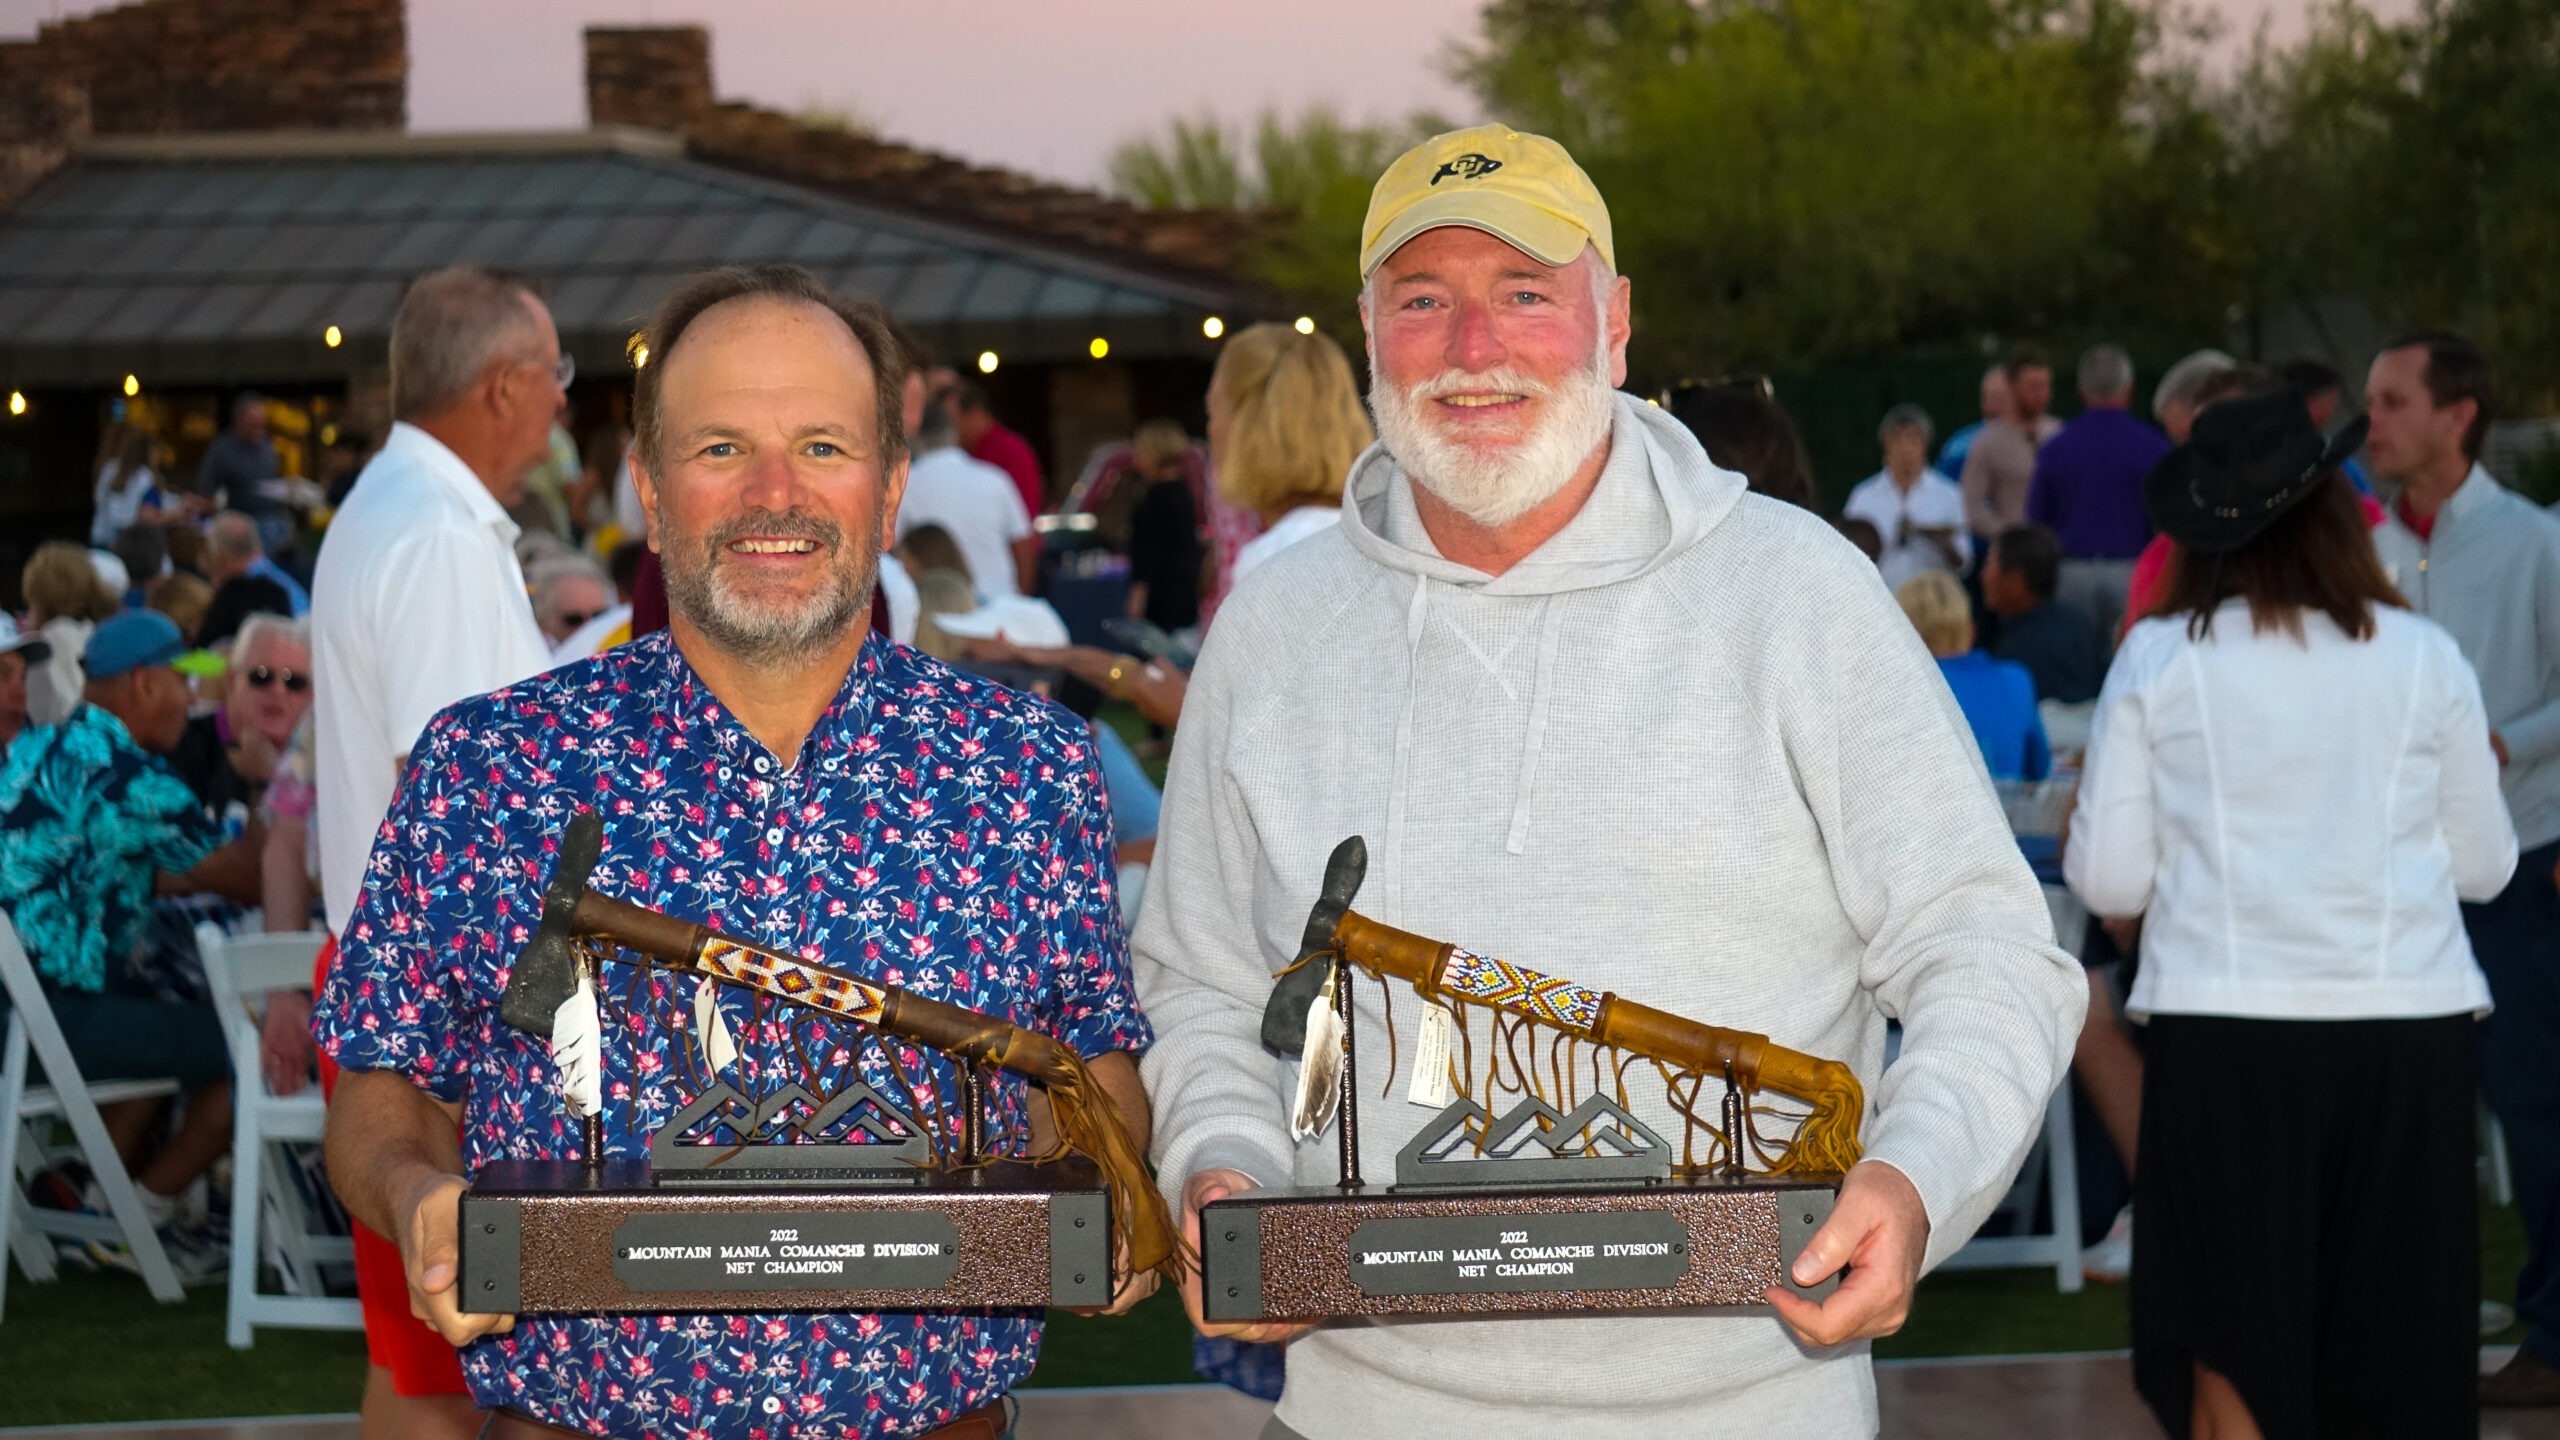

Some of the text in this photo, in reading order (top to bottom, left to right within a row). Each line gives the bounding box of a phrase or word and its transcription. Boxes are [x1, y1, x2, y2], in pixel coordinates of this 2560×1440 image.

[770, 1228, 799, 1242] 2022
[1500, 1230, 1529, 1244] 2022
[628, 1243, 940, 1260] MOUNTAIN MANIA COMANCHE DIVISION
[1363, 1242, 1669, 1265] MOUNTAIN MANIA COMANCHE DIVISION
[726, 1260, 845, 1275] NET CHAMPION
[1458, 1261, 1575, 1278] NET CHAMPION
